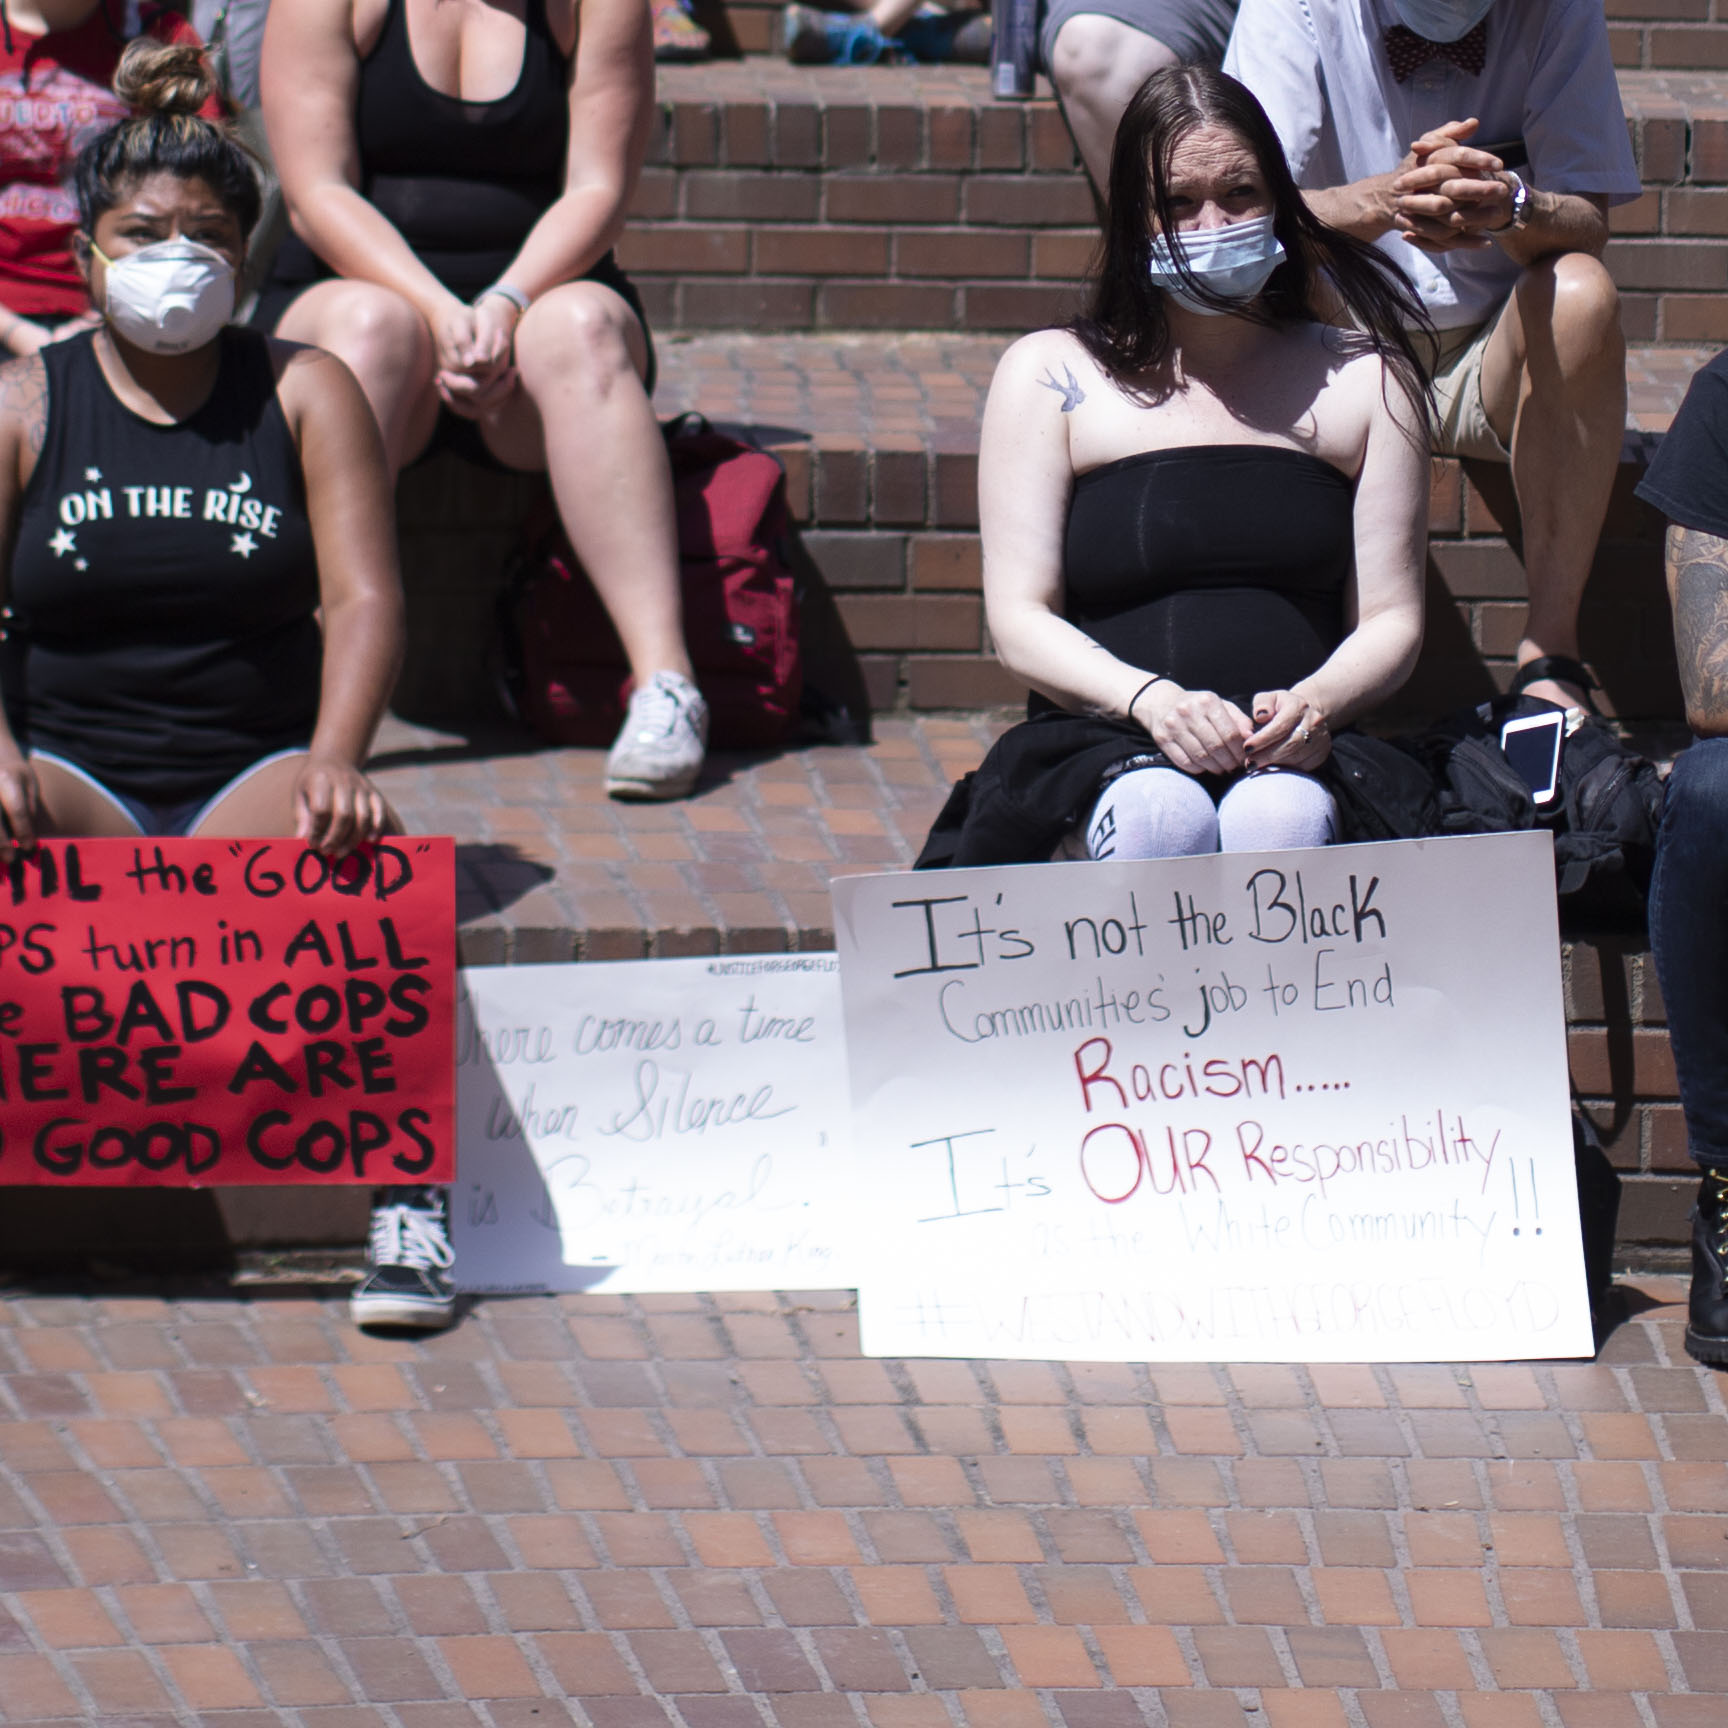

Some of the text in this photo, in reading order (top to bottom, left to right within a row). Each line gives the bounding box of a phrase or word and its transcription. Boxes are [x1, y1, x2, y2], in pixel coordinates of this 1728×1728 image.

[59, 486, 283, 539] ON THE RISE
[126, 845, 219, 896] the
[81, 925, 198, 972] turn
[218, 920, 265, 967] in
[283, 917, 431, 972] ALL
[891, 889, 1036, 979] It's
[1063, 889, 1149, 961] not
[1167, 889, 1235, 951] the
[60, 979, 232, 1045] BAD
[247, 973, 433, 1038] COPS
[575, 1012, 684, 1057] comes
[696, 1017, 724, 1047] a
[738, 993, 817, 1045] time
[1182, 968, 1249, 1040] job
[1262, 969, 1299, 1018] to
[1313, 948, 1397, 1012] End
[227, 1036, 397, 1098] ARE
[597, 1058, 800, 1143] Silence
[31, 1116, 223, 1176] GOOD
[246, 1107, 437, 1179] COPS
[908, 1128, 1055, 1224] It's
[1079, 1122, 1224, 1206] OUR
[1234, 1108, 1504, 1202] Responsibility
[467, 1183, 500, 1227] is
[1301, 1192, 1503, 1270] Community
